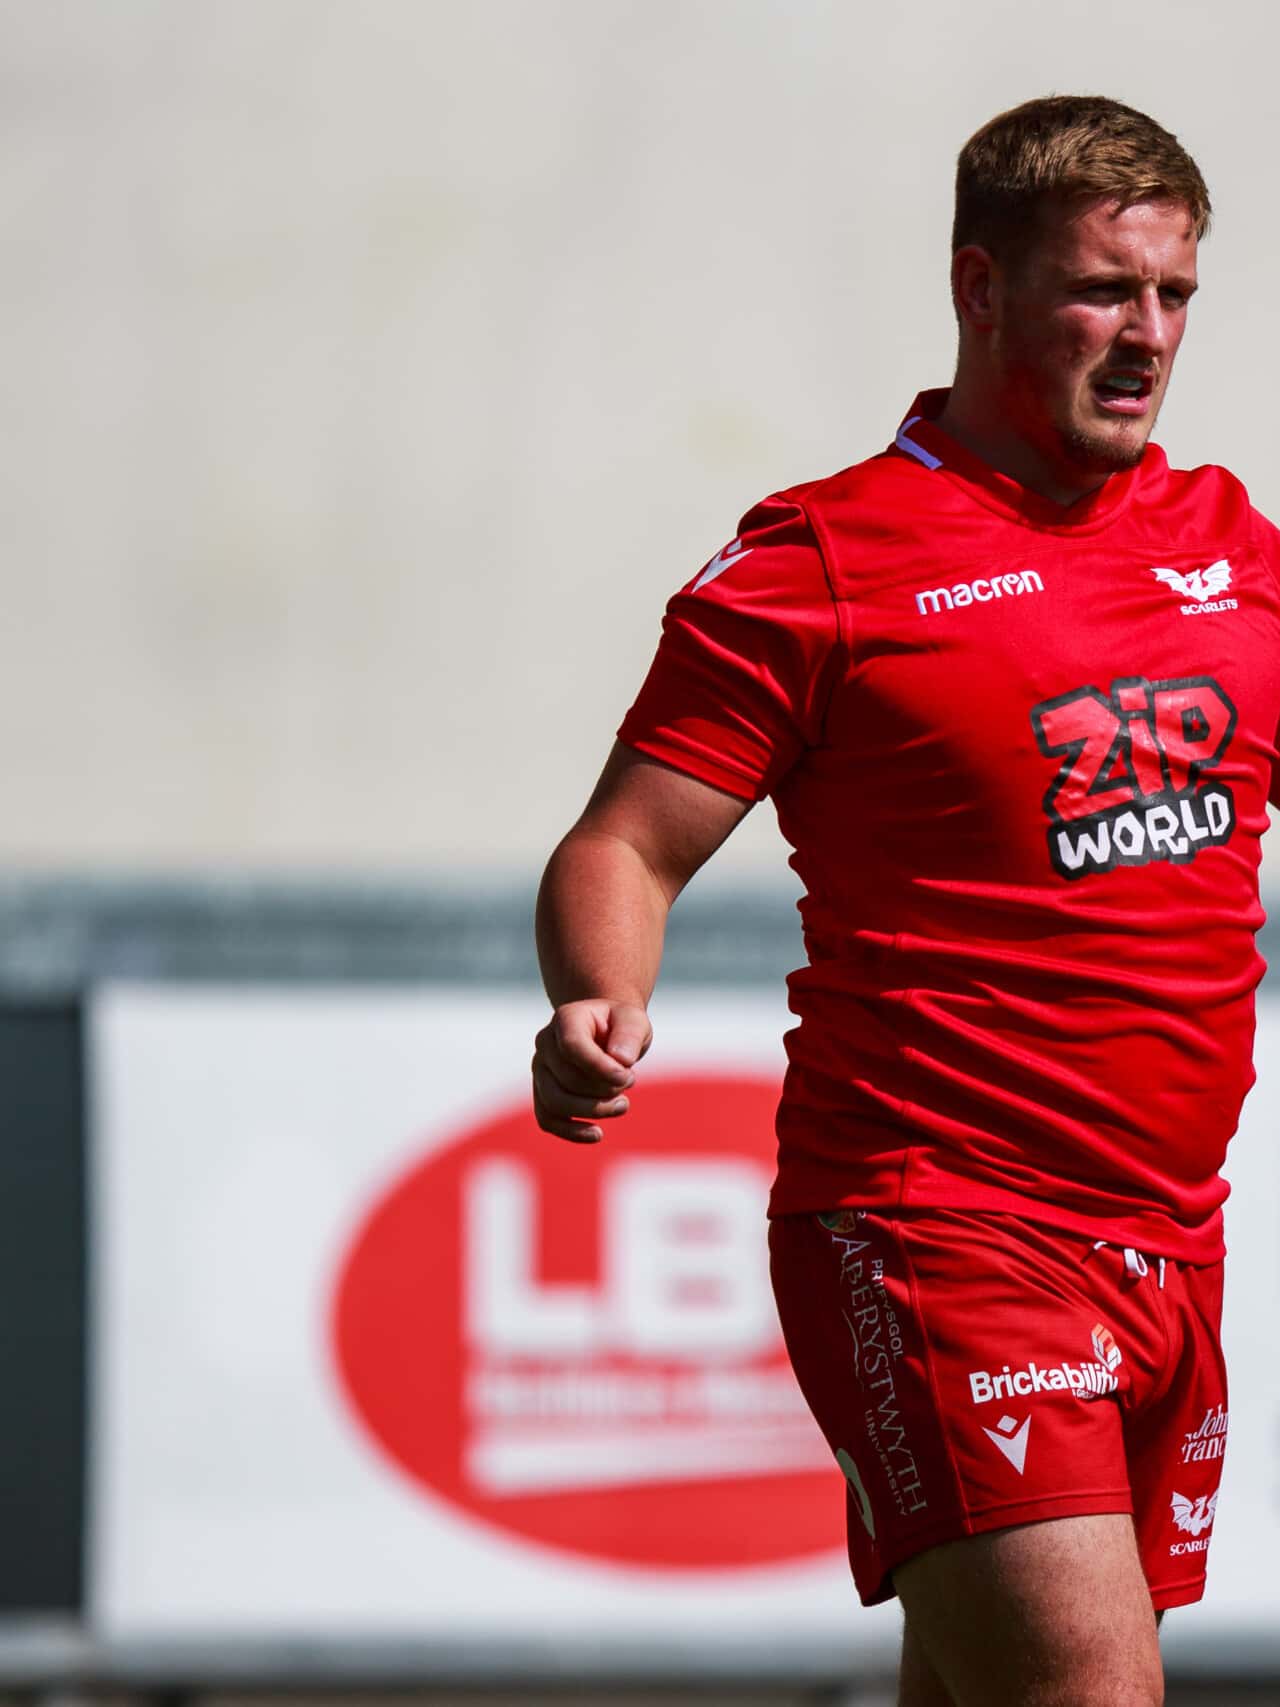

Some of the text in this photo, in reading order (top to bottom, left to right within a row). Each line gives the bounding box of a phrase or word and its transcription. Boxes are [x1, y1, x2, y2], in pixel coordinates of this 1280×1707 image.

[914, 569, 1045, 615] macron
[1180, 598, 1239, 615] SCARLETS
[1057, 791, 1231, 871] WORLD
[832, 1234, 928, 1513] ABERYSTWYTH
